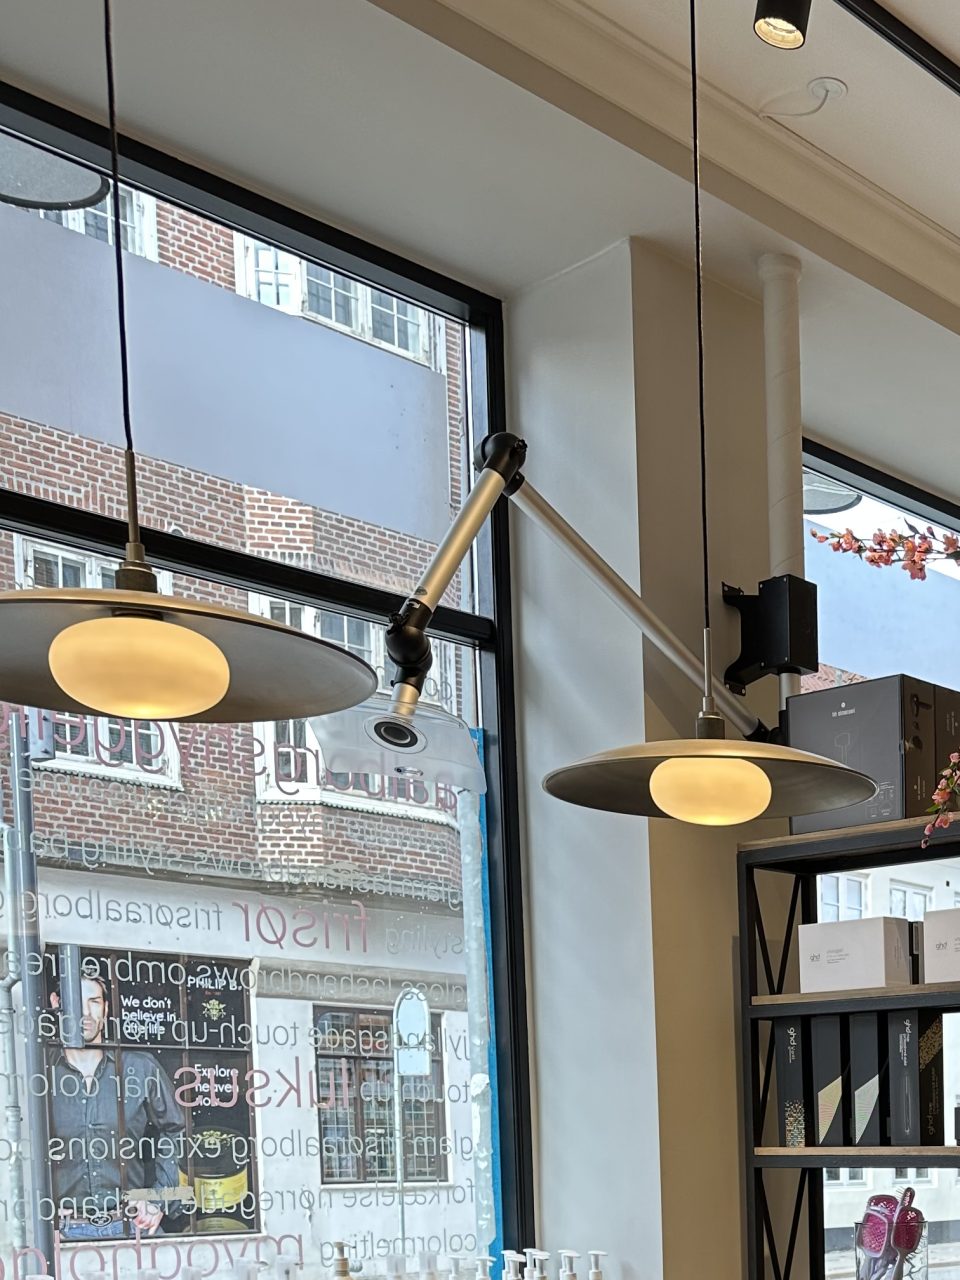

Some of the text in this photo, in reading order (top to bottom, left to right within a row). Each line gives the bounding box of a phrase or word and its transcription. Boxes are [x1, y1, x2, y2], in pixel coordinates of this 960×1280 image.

[935, 941, 948, 951] ghd
[809, 953, 821, 962] ghd
[120, 994, 172, 1009] We don't
[121, 1008, 177, 1022] believe in
[904, 1019, 912, 1034] ghd
[787, 1027, 797, 1046] ghd
[194, 1063, 239, 1079] Explore
